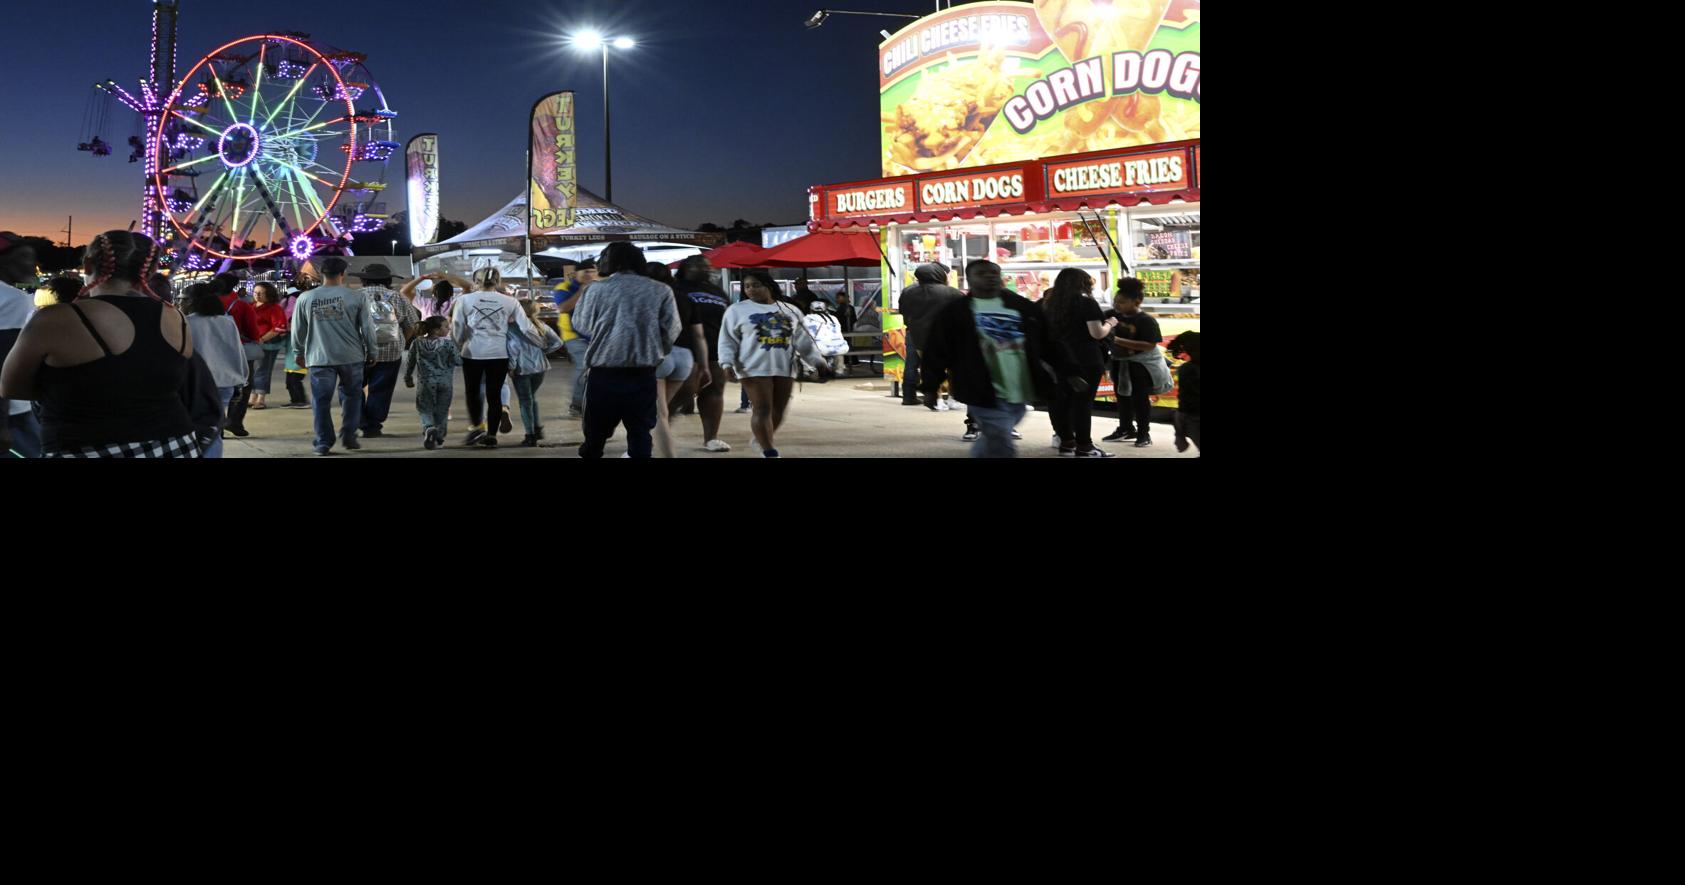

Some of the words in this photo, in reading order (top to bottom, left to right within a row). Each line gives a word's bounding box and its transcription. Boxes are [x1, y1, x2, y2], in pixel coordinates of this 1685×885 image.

[883, 33, 919, 77] CHILI
[920, 15, 978, 56] CHEESE
[1003, 55, 1105, 134] CORN
[1112, 49, 1200, 103] DOG
[922, 180, 970, 205] CORN
[971, 174, 1024, 201] DOGS
[1053, 161, 1123, 193] CHEESE
[1124, 155, 1183, 186] FRIES
[836, 186, 905, 213] BURGERS
